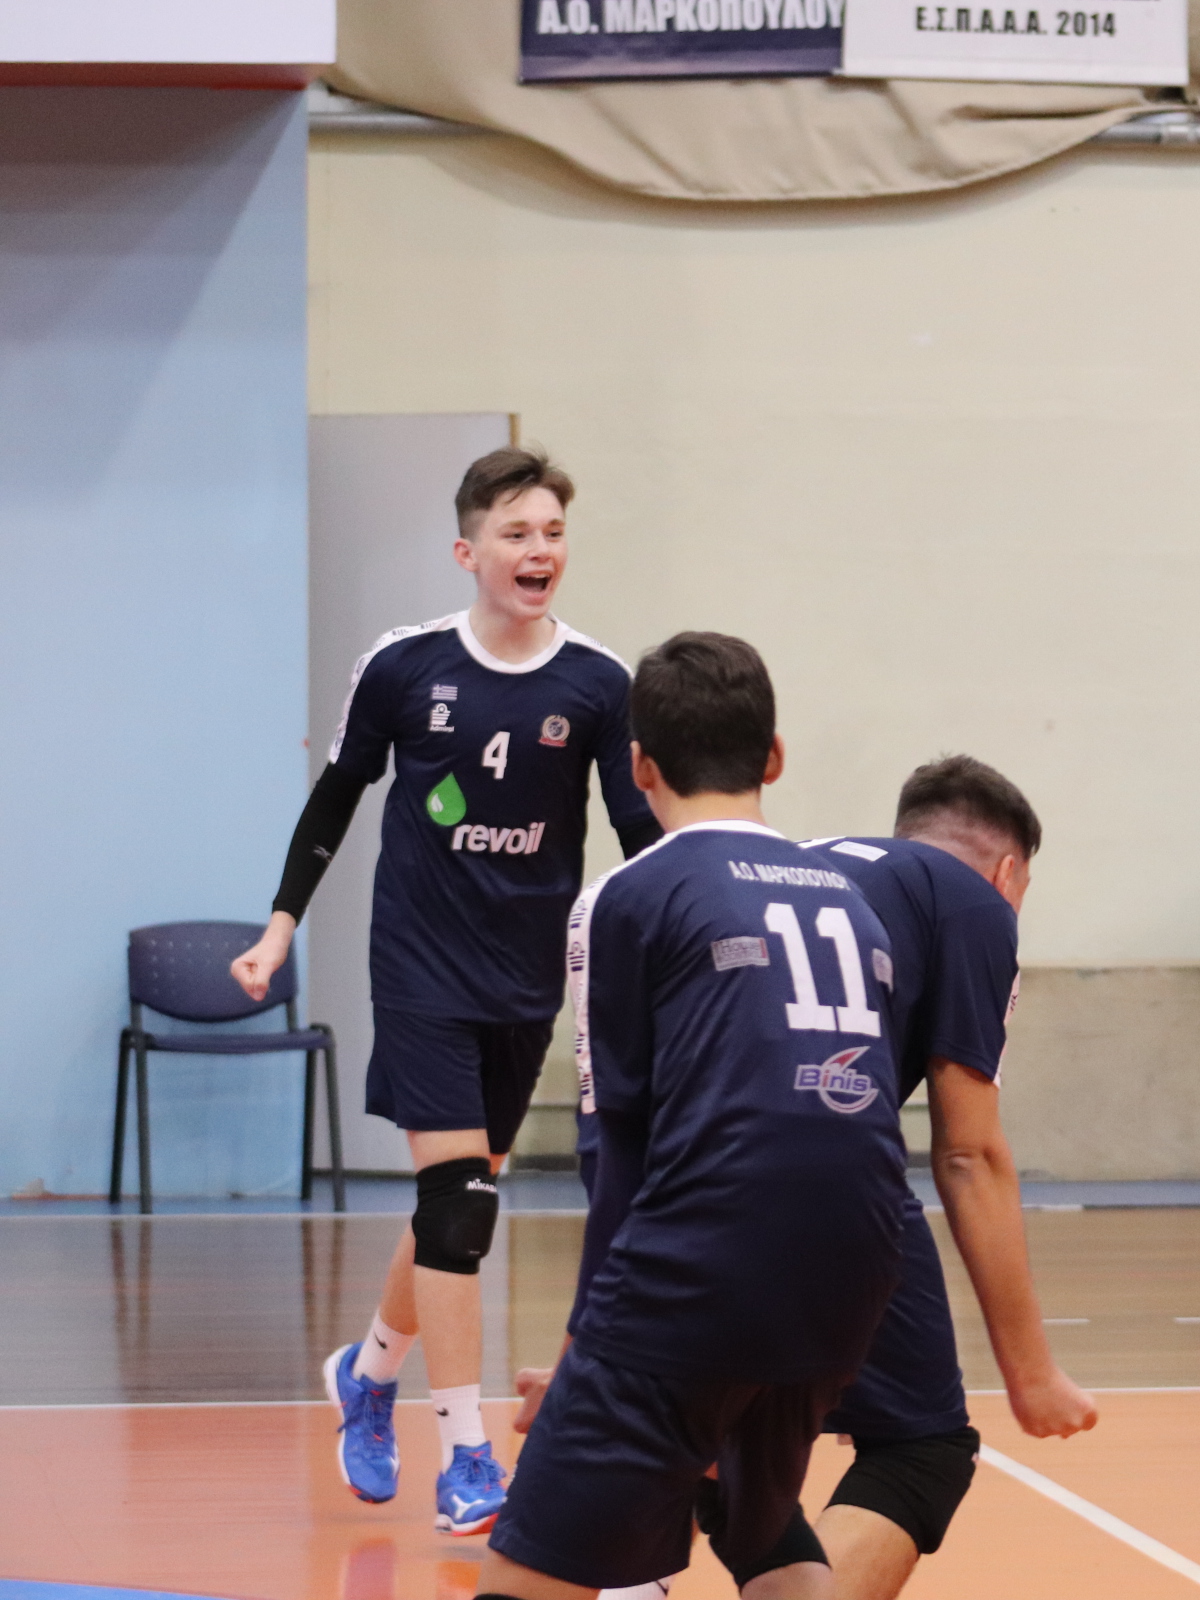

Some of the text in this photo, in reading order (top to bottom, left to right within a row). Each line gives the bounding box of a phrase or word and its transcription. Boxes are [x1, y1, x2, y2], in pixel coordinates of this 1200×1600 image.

[1057, 11, 1116, 37] 2014
[482, 731, 511, 779] 4
[452, 822, 546, 854] revoil
[764, 902, 881, 1038] 11
[799, 1068, 868, 1092] Binis
